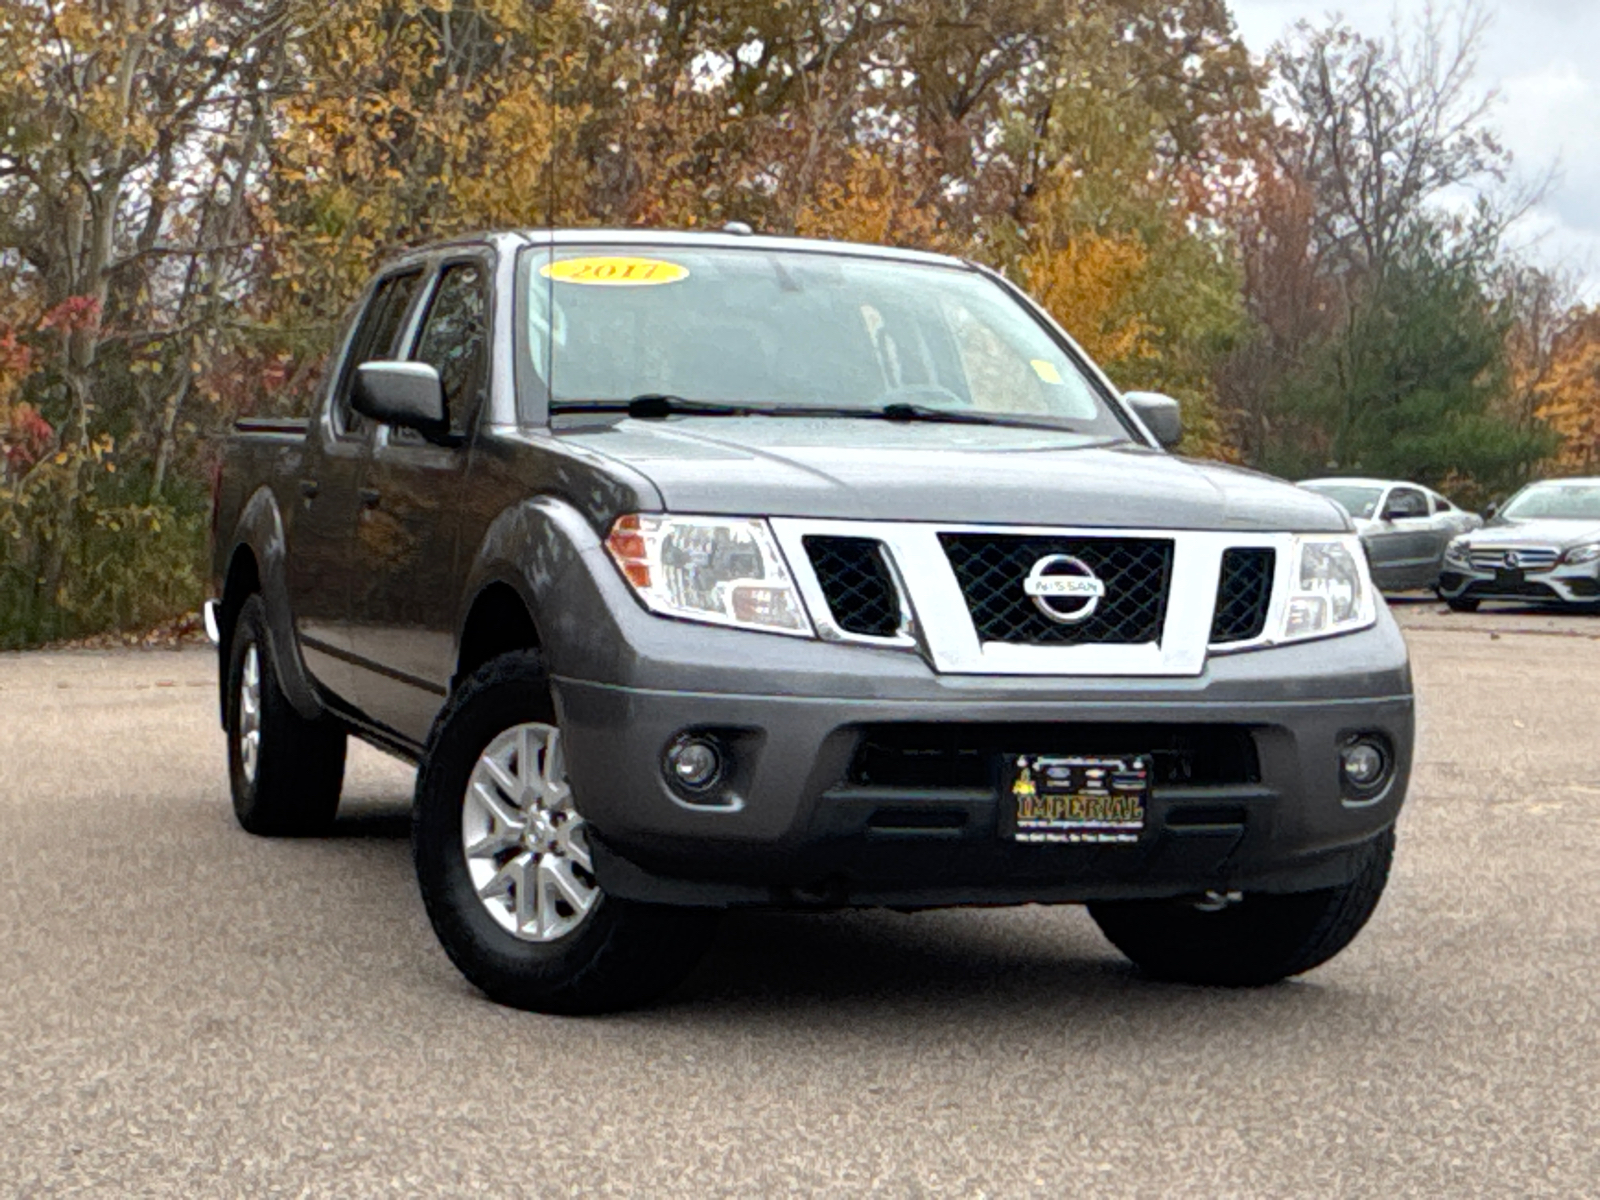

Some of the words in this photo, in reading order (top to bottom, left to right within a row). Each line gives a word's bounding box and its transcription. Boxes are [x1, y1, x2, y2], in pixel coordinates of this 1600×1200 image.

[569, 264, 659, 279] 2017
[1035, 580, 1097, 592] NISSAN
[1017, 794, 1143, 820] IMPERIAL
